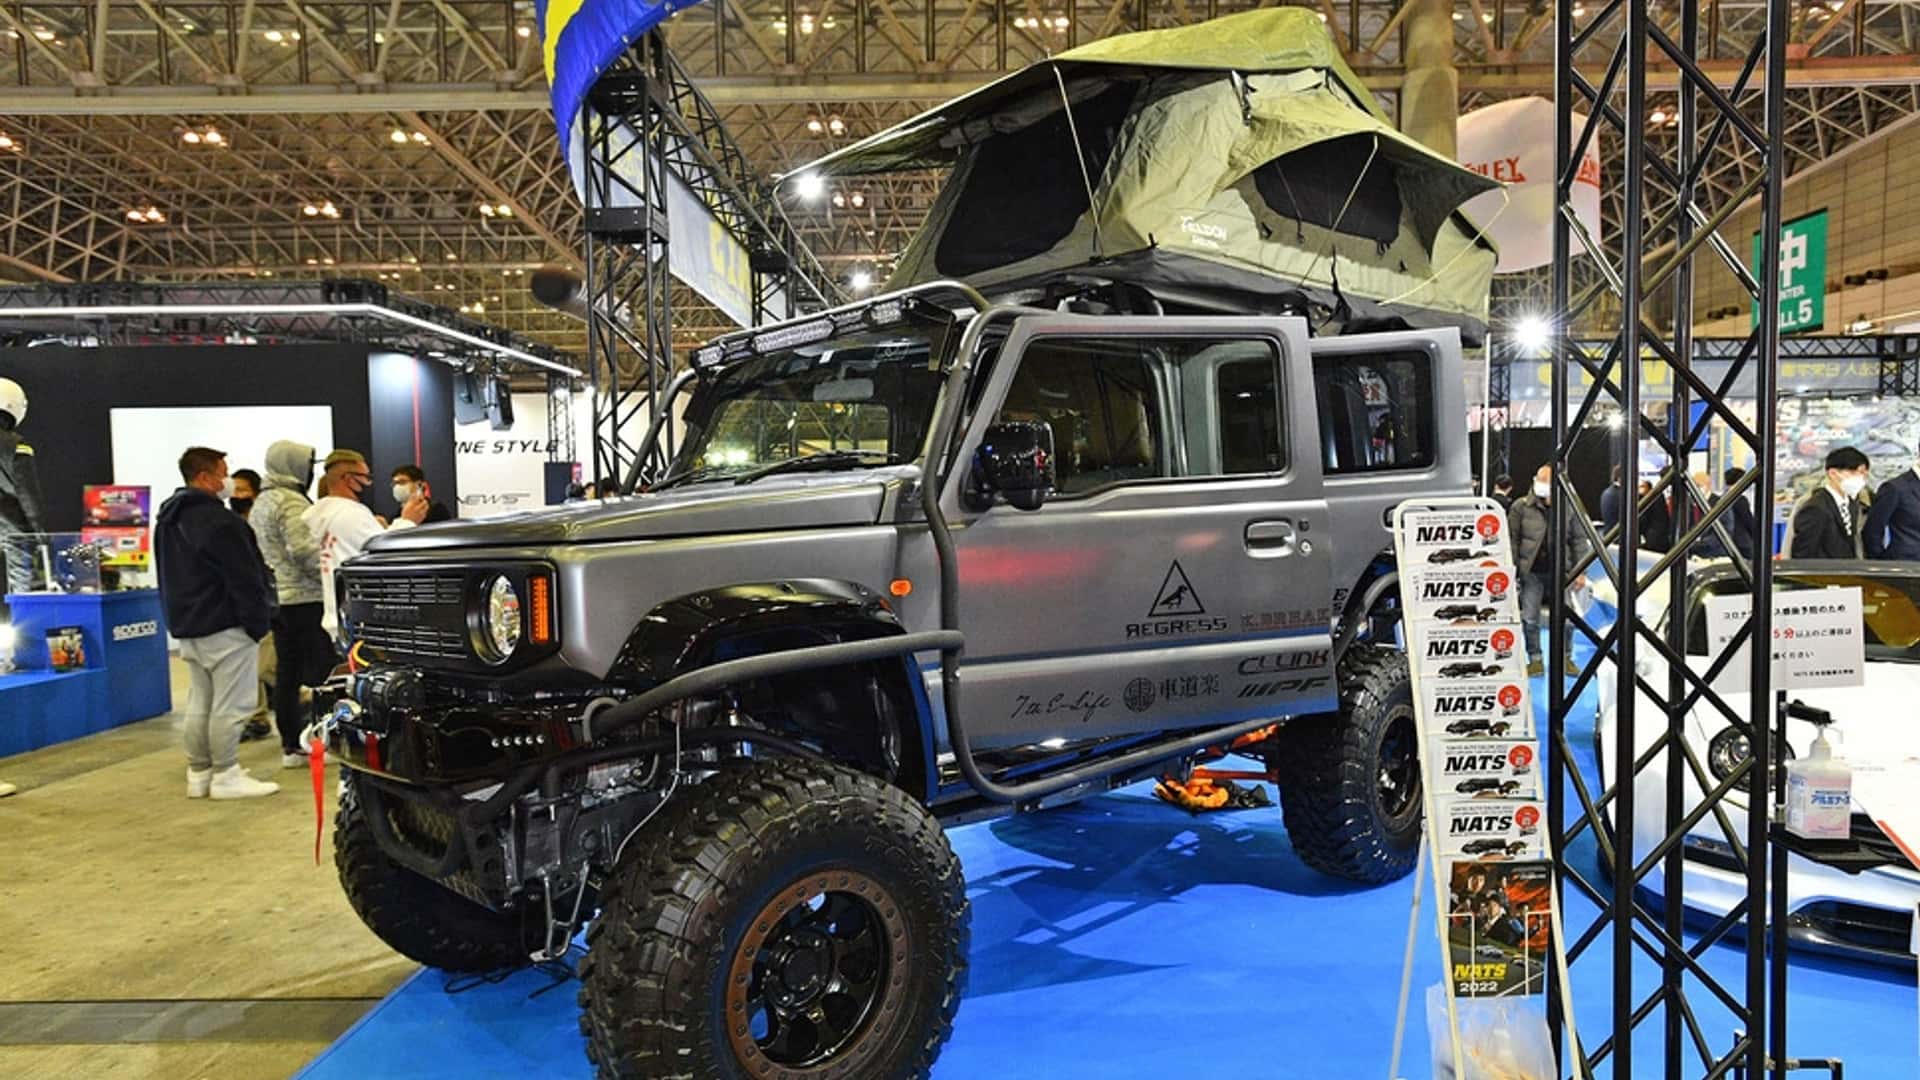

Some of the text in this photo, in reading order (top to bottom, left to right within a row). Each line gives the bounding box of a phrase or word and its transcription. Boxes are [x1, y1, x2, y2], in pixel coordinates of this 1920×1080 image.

[1798, 298, 1813, 323] 5
[492, 440, 558, 454] STYLE
[1416, 525, 1475, 542] NATS
[1423, 581, 1484, 598] NATS
[1126, 617, 1228, 638] REGRESS
[1427, 639, 1489, 656] NATS
[1434, 695, 1496, 713] NATS
[1444, 755, 1506, 772] NATS
[1450, 816, 1513, 833] NATS
[1454, 962, 1507, 978] NATS
[1459, 981, 1498, 992] 2022
